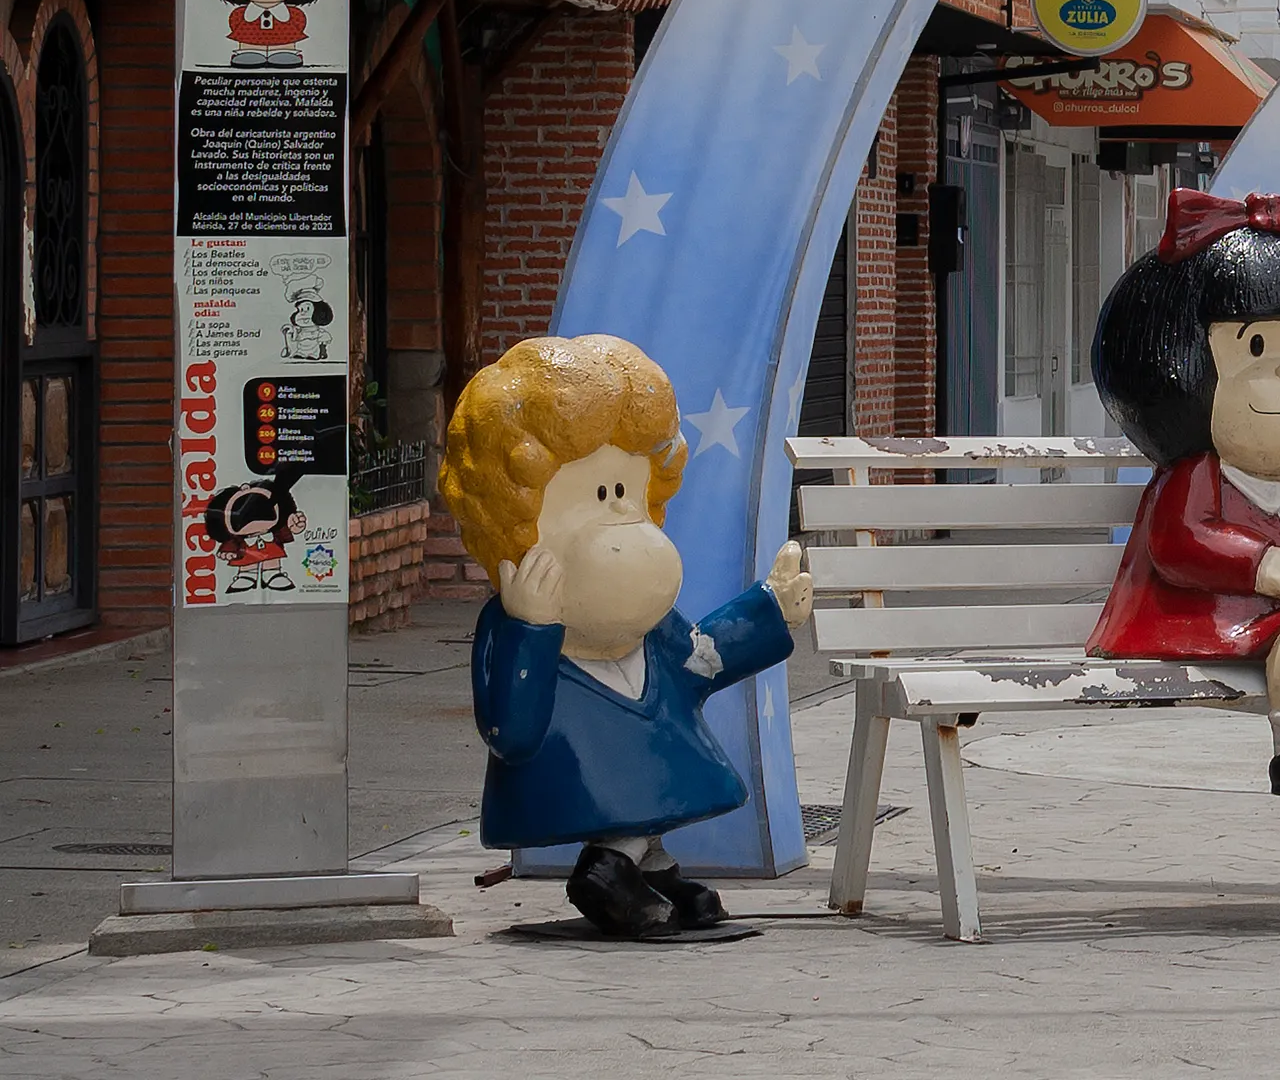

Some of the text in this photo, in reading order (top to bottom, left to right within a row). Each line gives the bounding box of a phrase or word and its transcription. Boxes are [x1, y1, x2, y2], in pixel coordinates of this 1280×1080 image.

[1066, 11, 1109, 24] ZULIA
[194, 75, 338, 89] Peculiar personaje que ostenta
[203, 87, 235, 96] mucha
[284, 87, 320, 99] ingenio
[322, 89, 329, 98] y
[196, 97, 247, 107] capacidad
[295, 97, 334, 107] Mafalda
[191, 109, 202, 117] es
[204, 109, 222, 117] una
[224, 107, 245, 117] niña
[246, 108, 283, 117] rebelde
[284, 110, 292, 120] y
[190, 127, 336, 141] Obra del caricaturista argentino
[244, 139, 281, 151] (Quino)
[283, 139, 325, 149] Salvador
[232, 149, 249, 160] Sus
[251, 150, 302, 160] historietas
[304, 152, 321, 160] son
[323, 152, 335, 160] un
[194, 160, 254, 170] instrumento
[256, 160, 269, 170] de
[303, 160, 332, 171] frente
[216, 171, 311, 183] a las desigualdades
[281, 184, 288, 194] y
[247, 192, 257, 202] el
[229, 212, 244, 221] del
[245, 212, 287, 223] Municipio
[288, 212, 332, 222] Libertador
[227, 222, 239, 230] 27
[241, 221, 253, 230] de
[254, 221, 297, 231] diciembre
[299, 222, 310, 231] de
[312, 222, 333, 231] 2023
[191, 238, 247, 248] Le gustan:
[191, 249, 246, 259] Los Beatles
[191, 259, 260, 268] La democracia
[192, 268, 269, 277] Los derechos de
[192, 277, 234, 286] los niños
[193, 286, 261, 296] Las panquecas
[193, 299, 237, 308] mafalda
[194, 309, 220, 317] odia:
[195, 320, 230, 330] La sopa
[195, 329, 261, 338] A James Bond
[196, 339, 211, 348] Las
[196, 348, 248, 358] Las guerras
[263, 387, 271, 397] 9
[260, 408, 275, 418] 26
